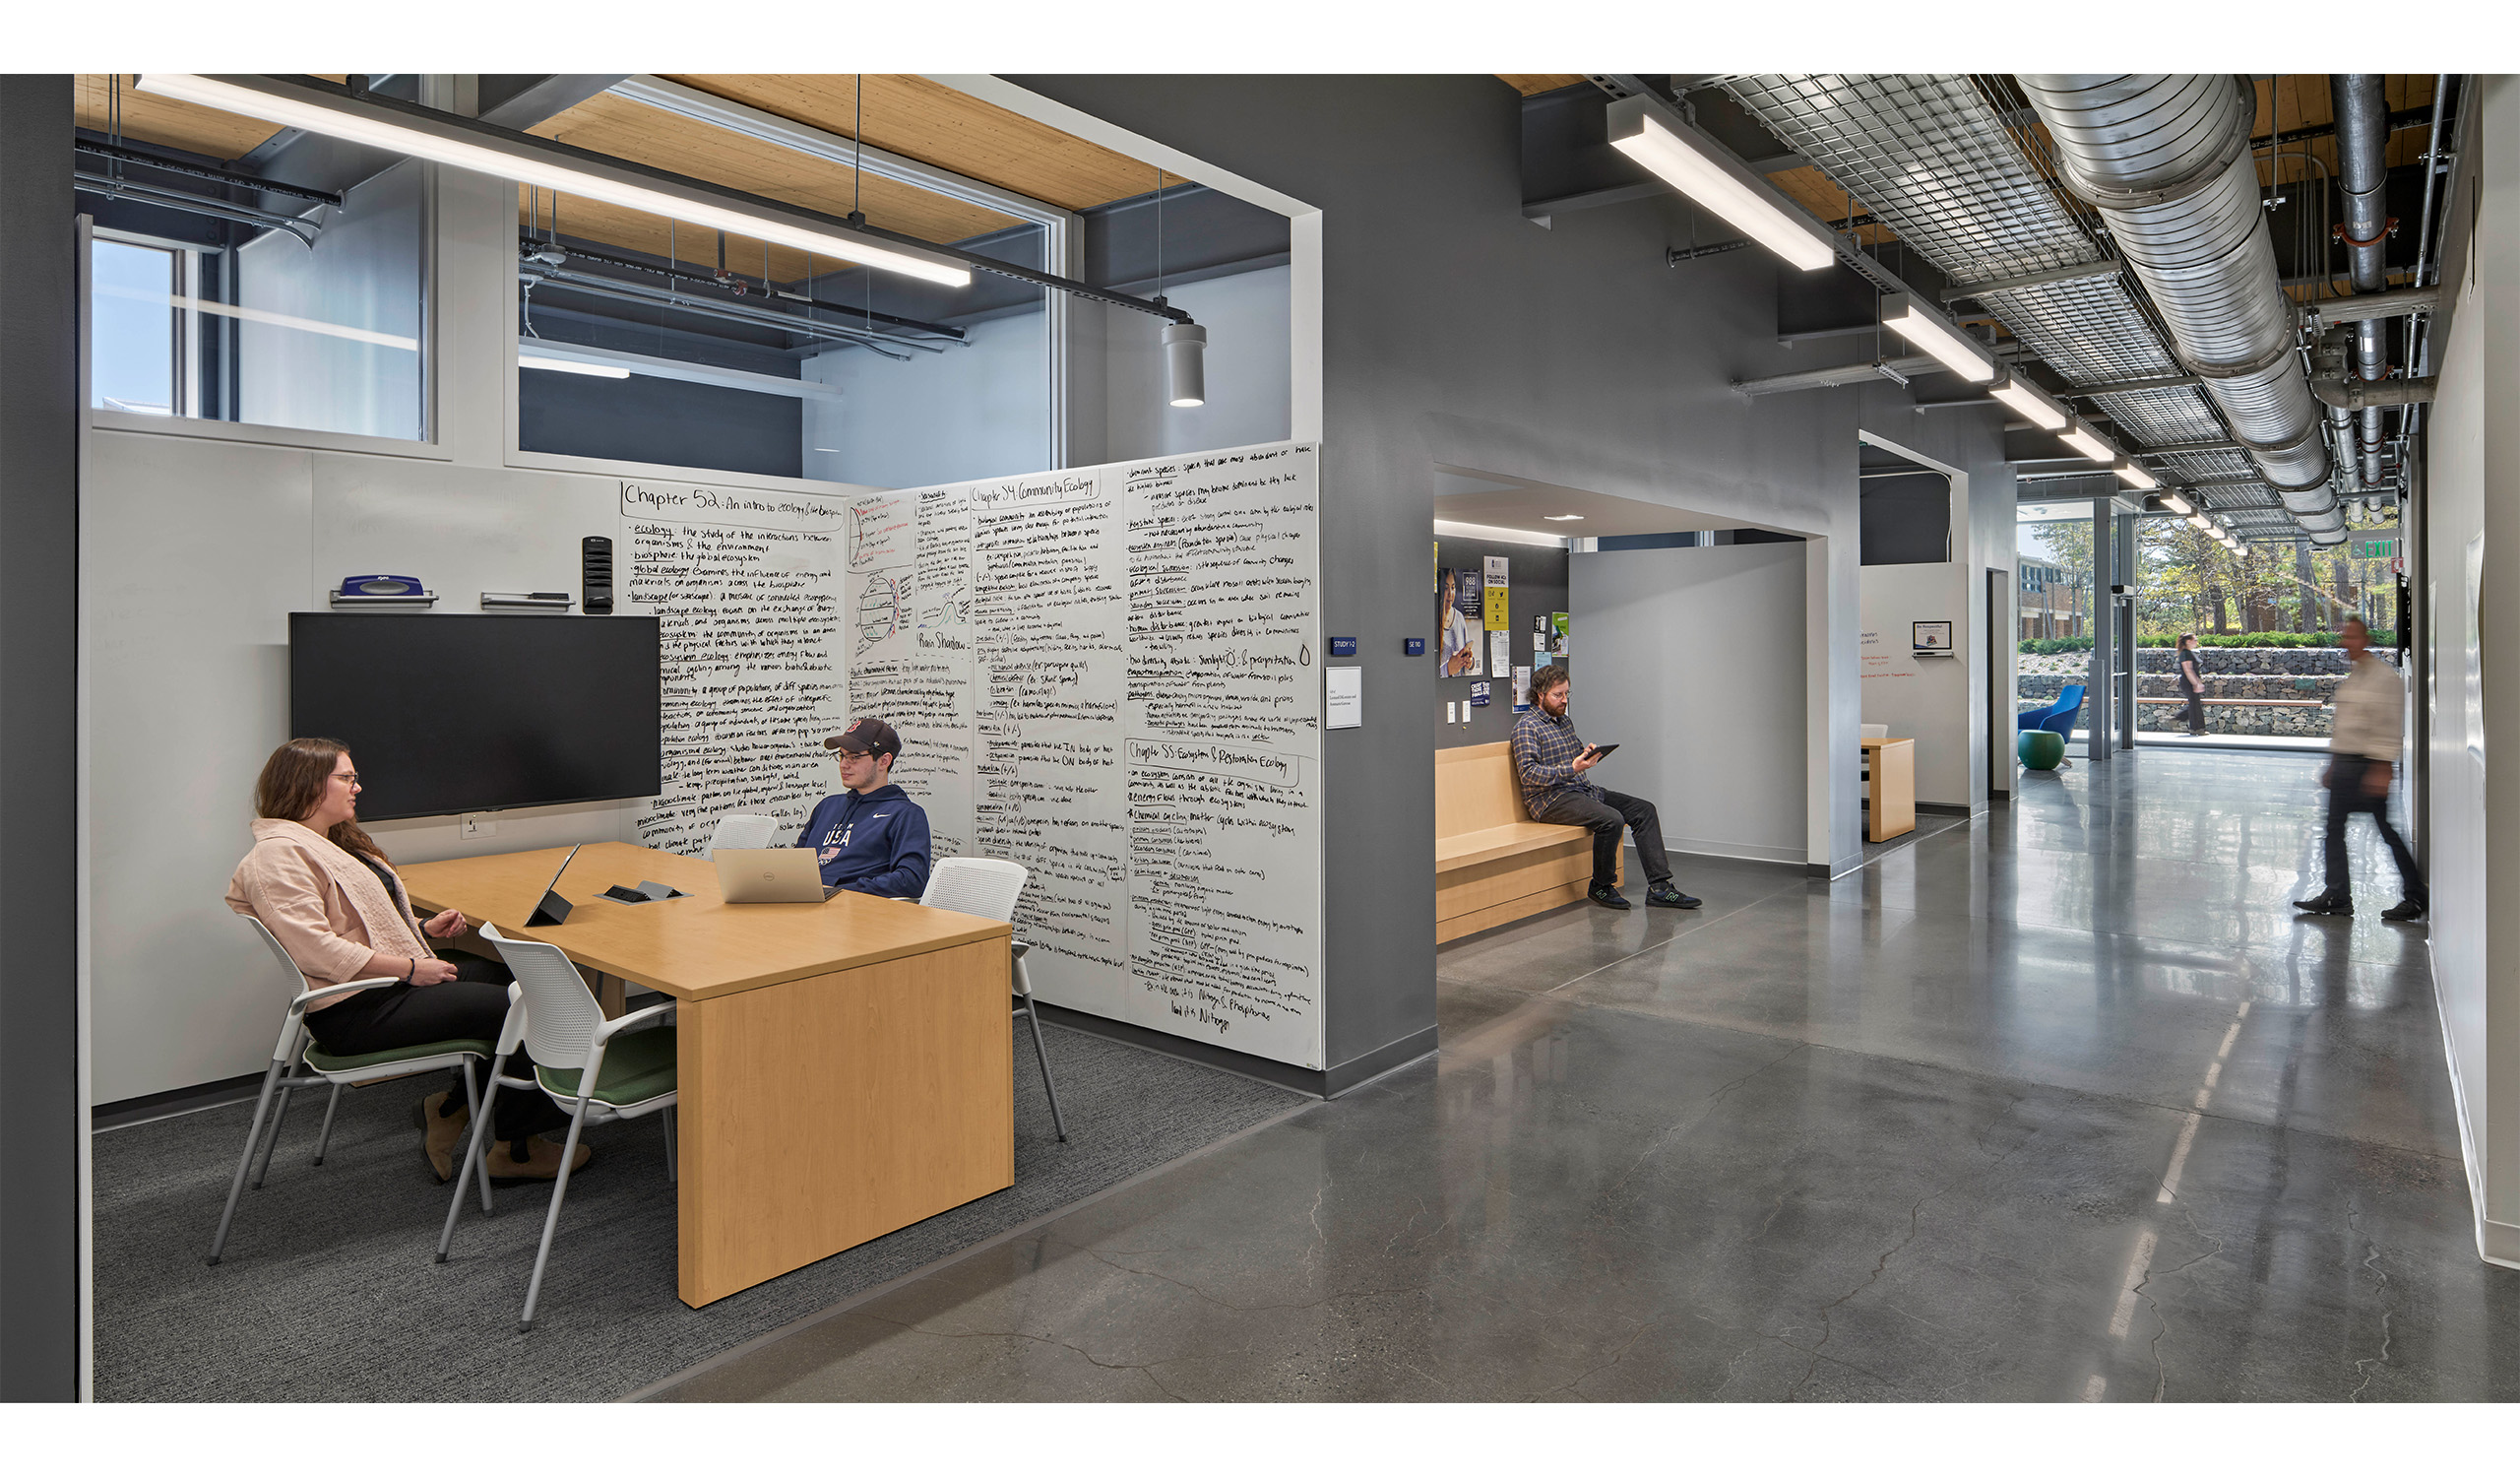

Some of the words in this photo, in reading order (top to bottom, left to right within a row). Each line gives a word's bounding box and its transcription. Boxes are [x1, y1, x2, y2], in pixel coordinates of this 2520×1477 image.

[625, 484, 688, 510] Chapter
[768, 503, 775, 512] to
[683, 527, 697, 537] the
[701, 530, 724, 544] study
[726, 530, 735, 539] of
[741, 531, 753, 540] the
[697, 542, 712, 550] the
[2365, 540, 2393, 558] EXIT
[823, 830, 851, 847] USA
